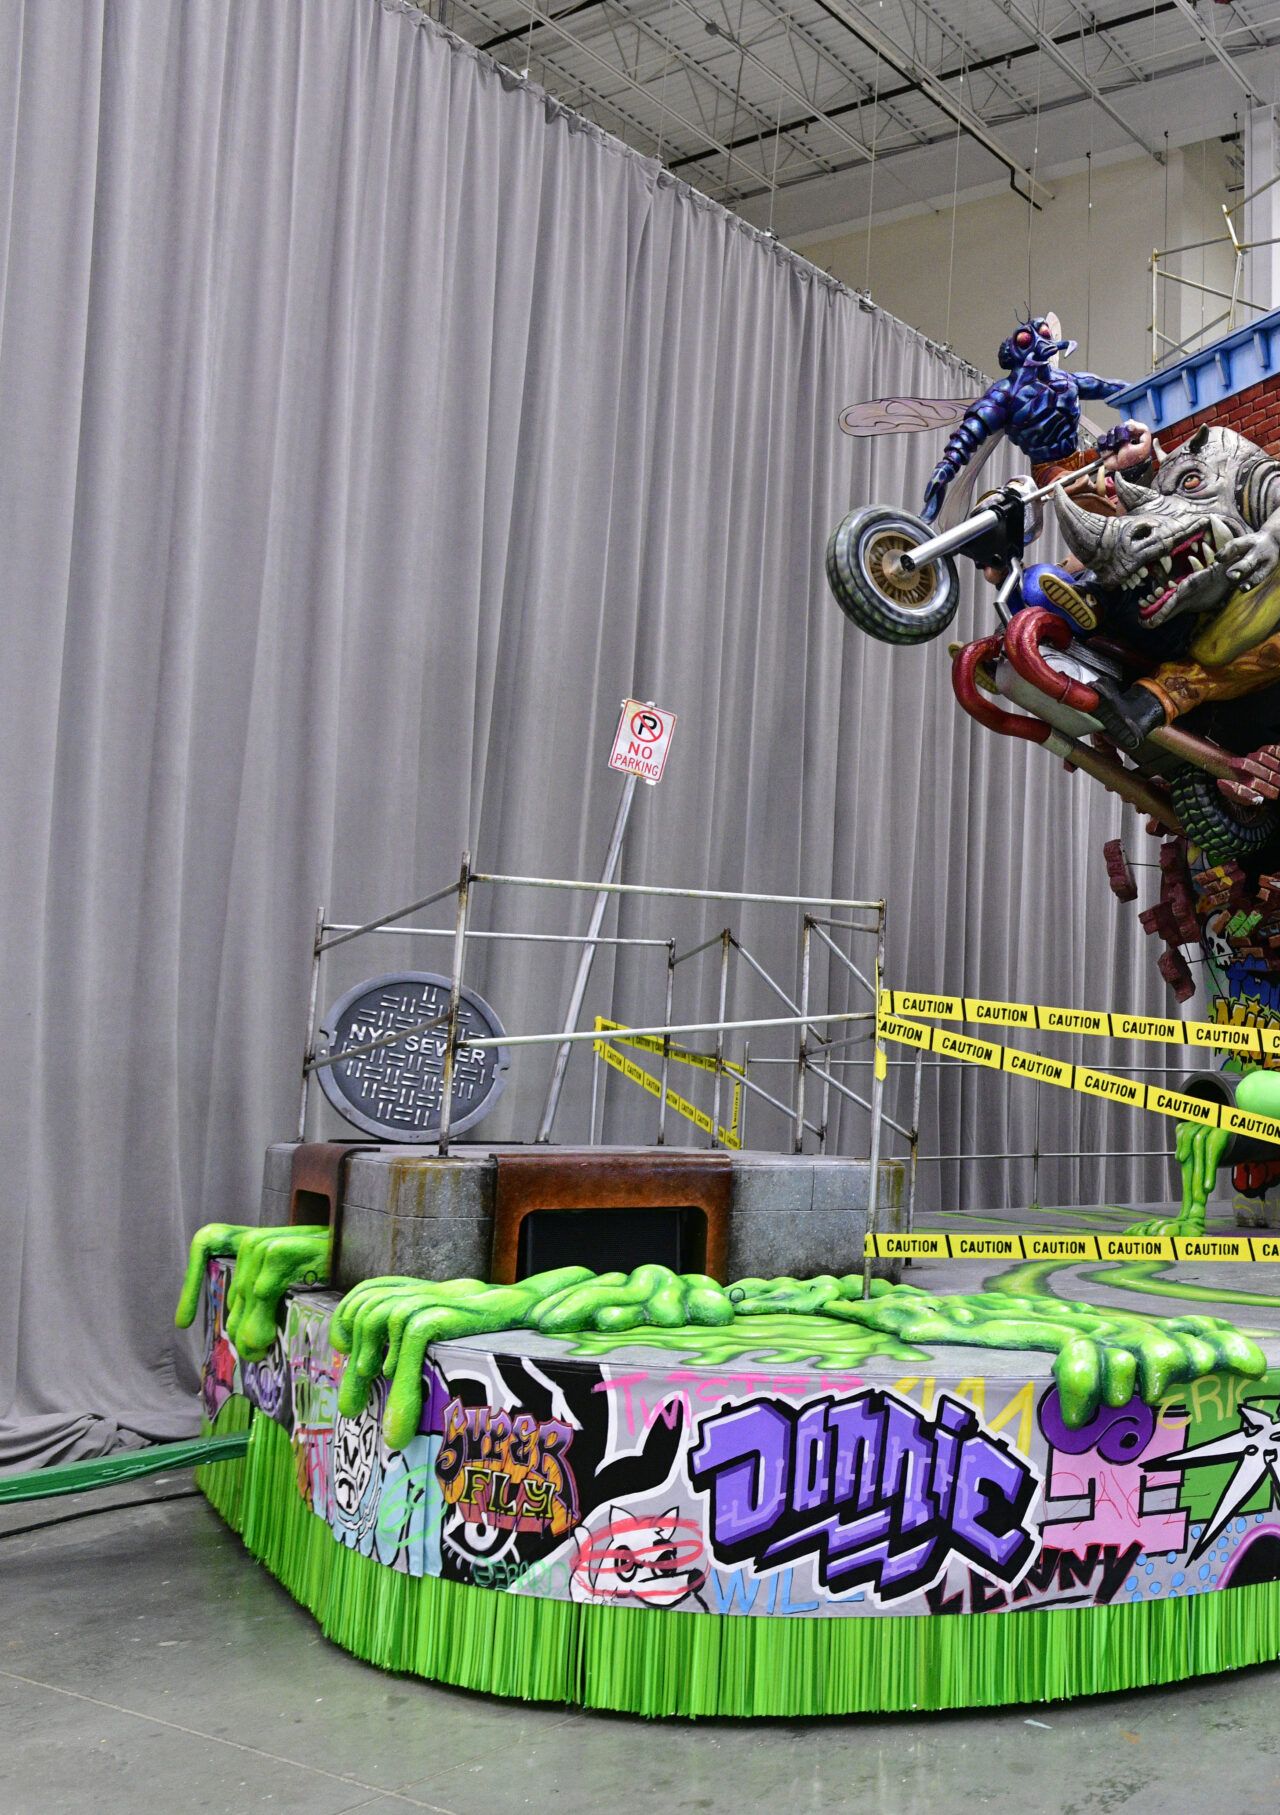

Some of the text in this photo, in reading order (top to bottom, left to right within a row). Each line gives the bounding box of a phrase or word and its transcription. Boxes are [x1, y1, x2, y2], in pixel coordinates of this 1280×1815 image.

[614, 753, 660, 777] PARKING
[628, 741, 653, 759] NO
[349, 1023, 397, 1047] NYC
[903, 998, 953, 1014] CAUTION
[976, 1006, 1028, 1022] CAUTION
[1049, 1013, 1100, 1030] CAUTION
[1122, 1021, 1174, 1037] CAUTION
[1197, 1029, 1249, 1044] CAUTION
[607, 1049, 622, 1066] CAUTION
[627, 1064, 642, 1081] CAUTION
[646, 1078, 660, 1093] CAUTION
[666, 1092, 678, 1105] AUTION
[942, 1038, 992, 1060] CAUTION
[1011, 1056, 1062, 1079] CAUTION
[1085, 1076, 1137, 1099] CAUTION
[1157, 1095, 1210, 1118] CAUTION
[887, 1240, 938, 1252] CAUTION
[960, 1240, 1012, 1253] CAUTION
[1033, 1241, 1085, 1254] CAUTION
[1108, 1242, 1161, 1254] CAUTION
[1185, 1243, 1239, 1256] CAUTION
[436, 1396, 579, 1530] SUPER
[462, 1466, 556, 1520] FLY
[711, 1566, 867, 1616] WIL
